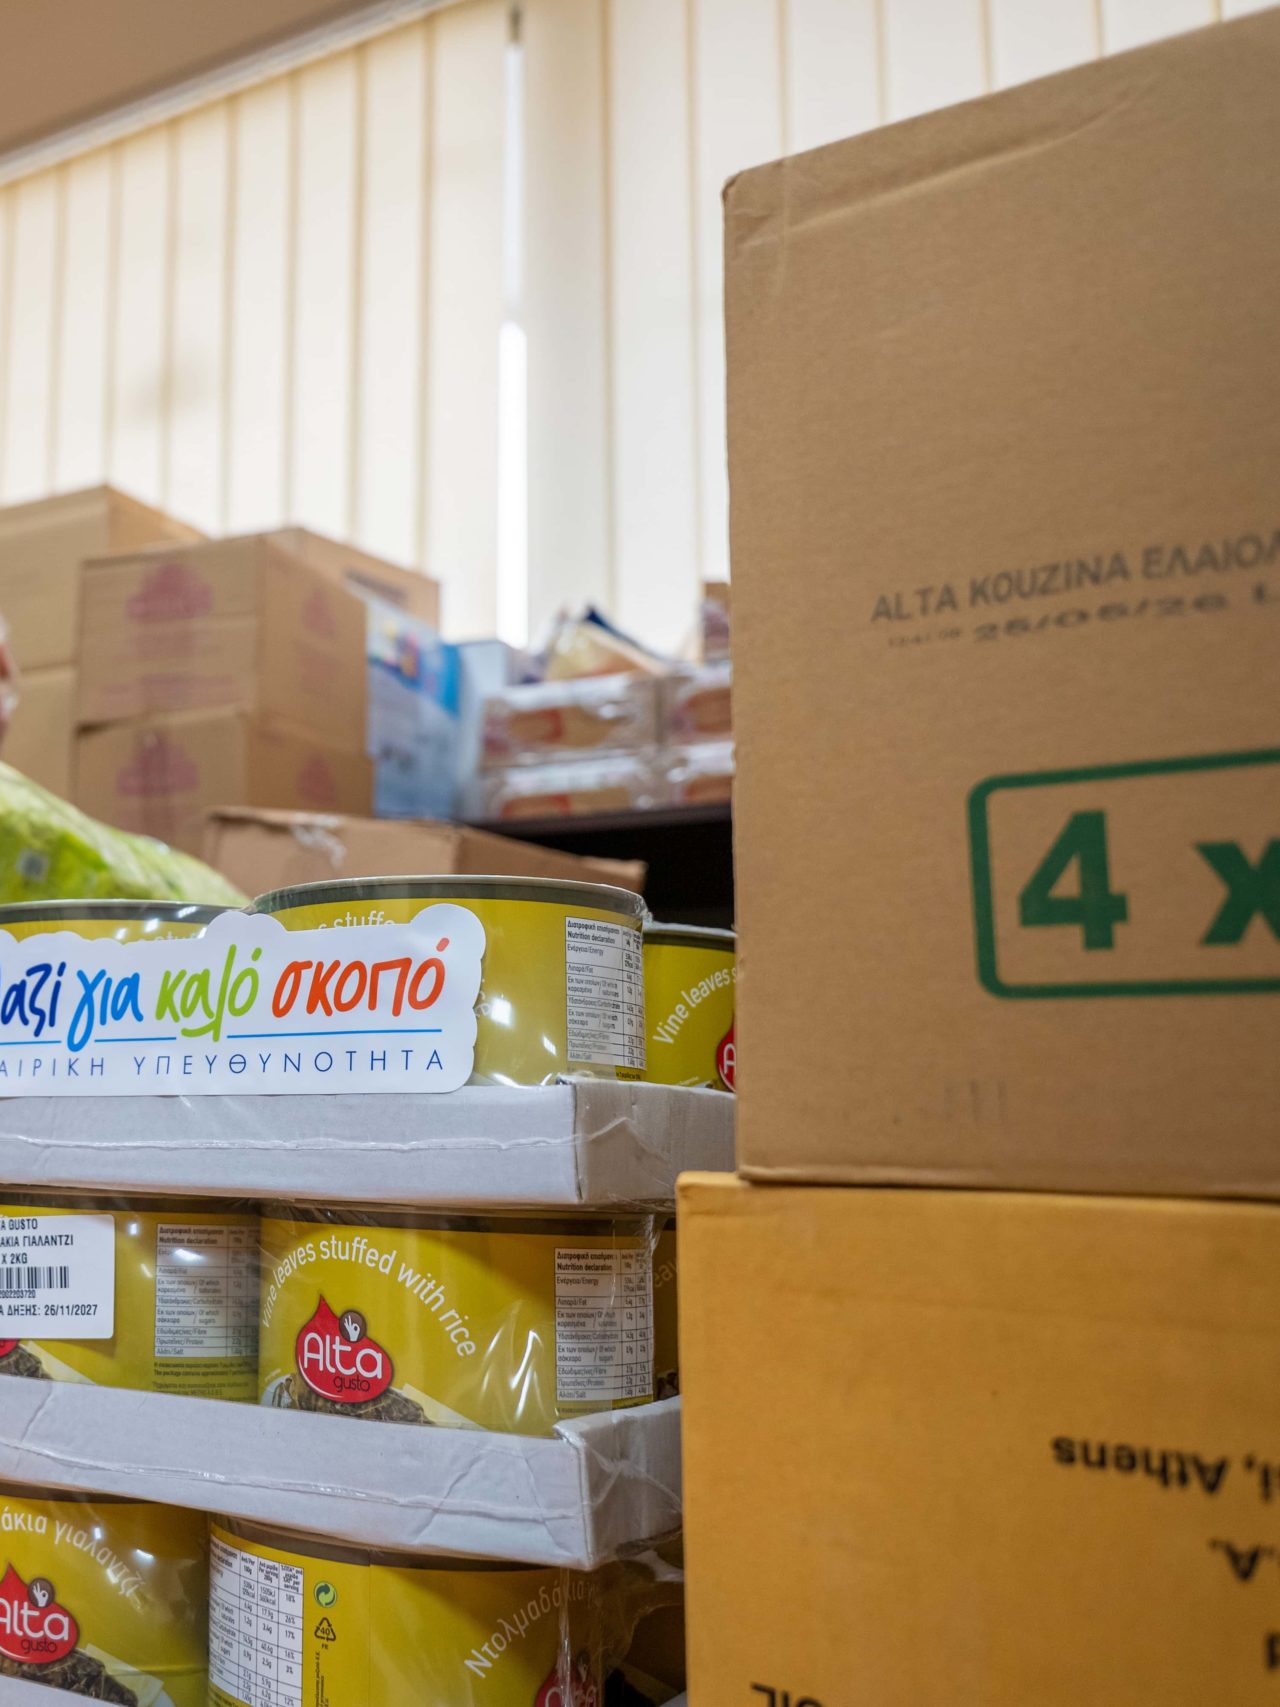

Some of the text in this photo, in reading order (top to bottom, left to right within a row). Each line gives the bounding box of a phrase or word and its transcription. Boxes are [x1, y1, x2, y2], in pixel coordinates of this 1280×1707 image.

[871, 584, 958, 622] ALTA
[1017, 810, 1129, 951] 4
[66, 966, 144, 1052] για
[155, 943, 263, 1042] καλό
[271, 937, 450, 1018] σκοπό
[652, 968, 731, 1046] Vine leaves
[133, 1049, 444, 1076] ΥΠΕΥΘΥΝΟΤΗΤΑ
[8, 1218, 38, 1231] GUSTO
[22, 1234, 74, 1247] ΓΙΑΛΑΝΤΖΙ
[1, 1253, 8, 1264] X
[10, 1253, 28, 1264] 2KG
[7, 1304, 41, 1316] ΔΗΞΗΣ:
[44, 1304, 98, 1316] 26/11/2027
[273, 1242, 317, 1289] leaves
[320, 1234, 397, 1275] stuffed
[397, 1262, 446, 1312] with
[438, 1307, 477, 1358] rice
[303, 1332, 384, 1379] Alta
[333, 1374, 371, 1393] gusto
[1051, 1436, 1228, 1496] Athens
[21, 1639, 58, 1654] gusto
